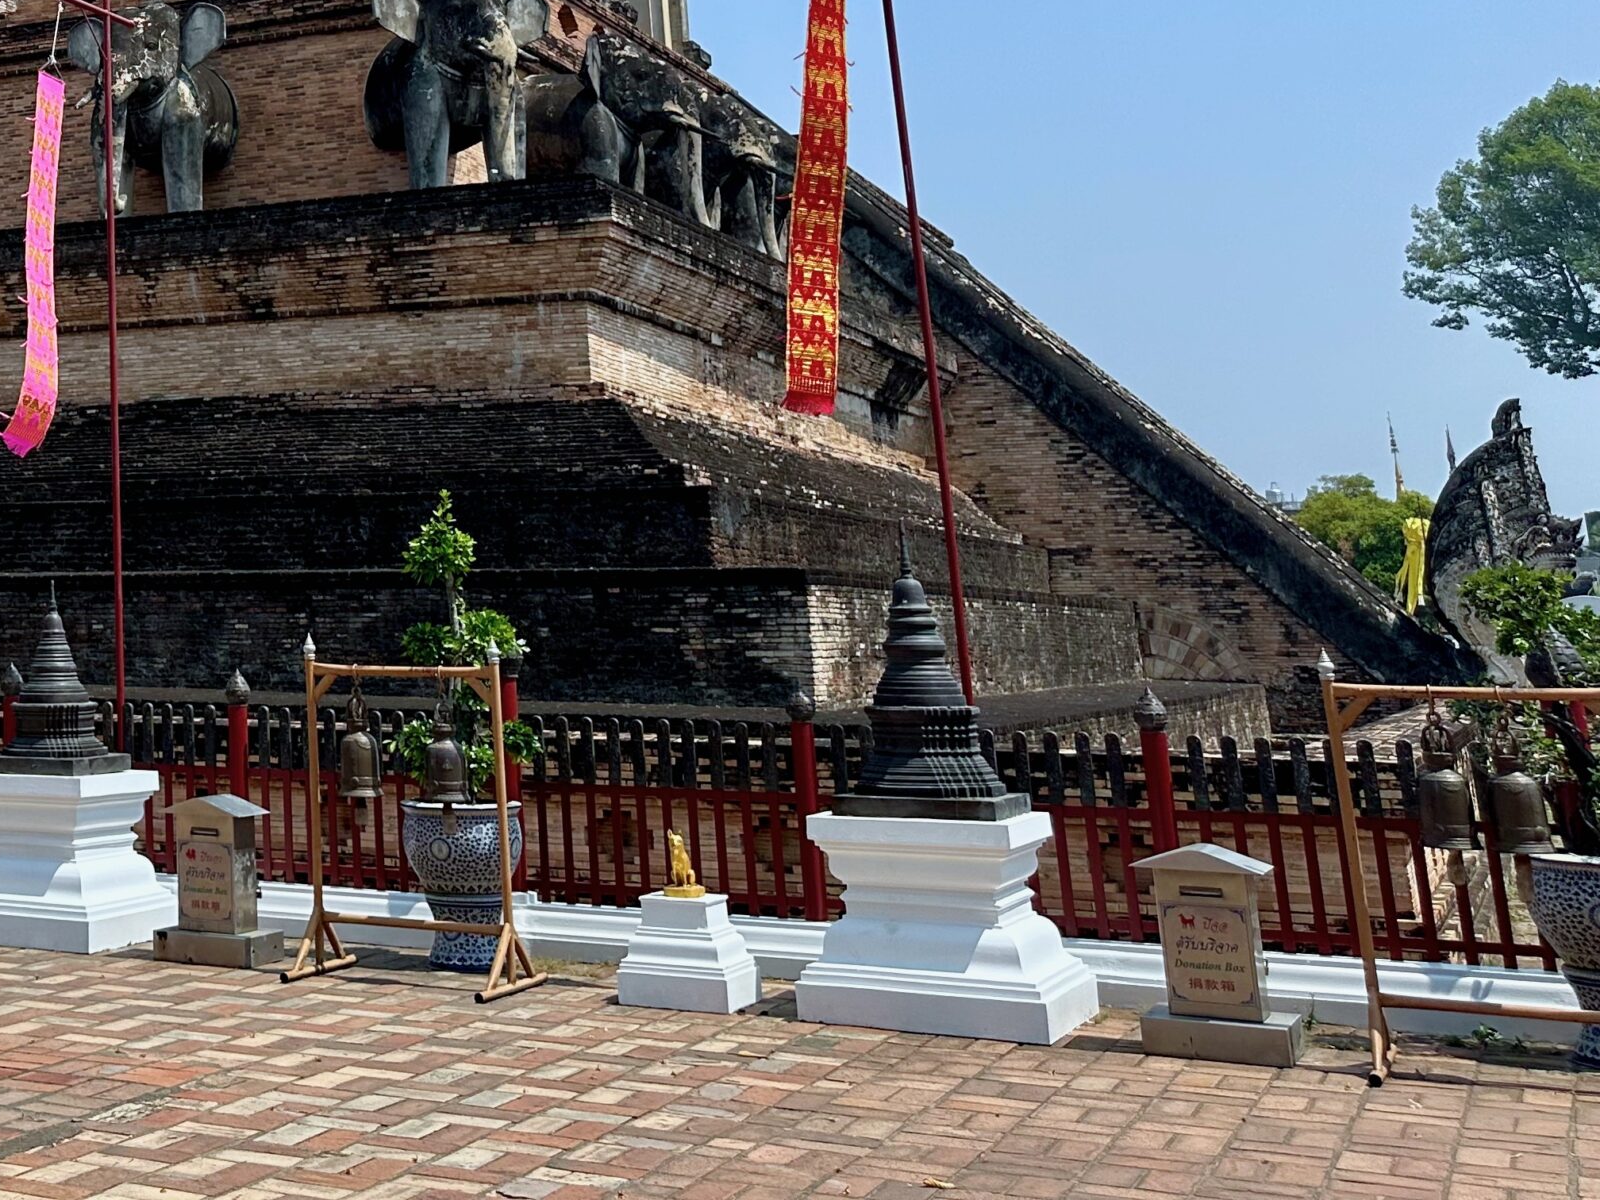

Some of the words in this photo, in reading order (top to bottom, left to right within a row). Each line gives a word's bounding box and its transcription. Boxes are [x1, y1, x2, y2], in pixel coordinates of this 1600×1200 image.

[1176, 935, 1239, 955] ตู้รับบริจาค
[1175, 958, 1222, 970] Donation
[1225, 962, 1246, 973] Box
[1188, 977, 1236, 992] 捐款箱
